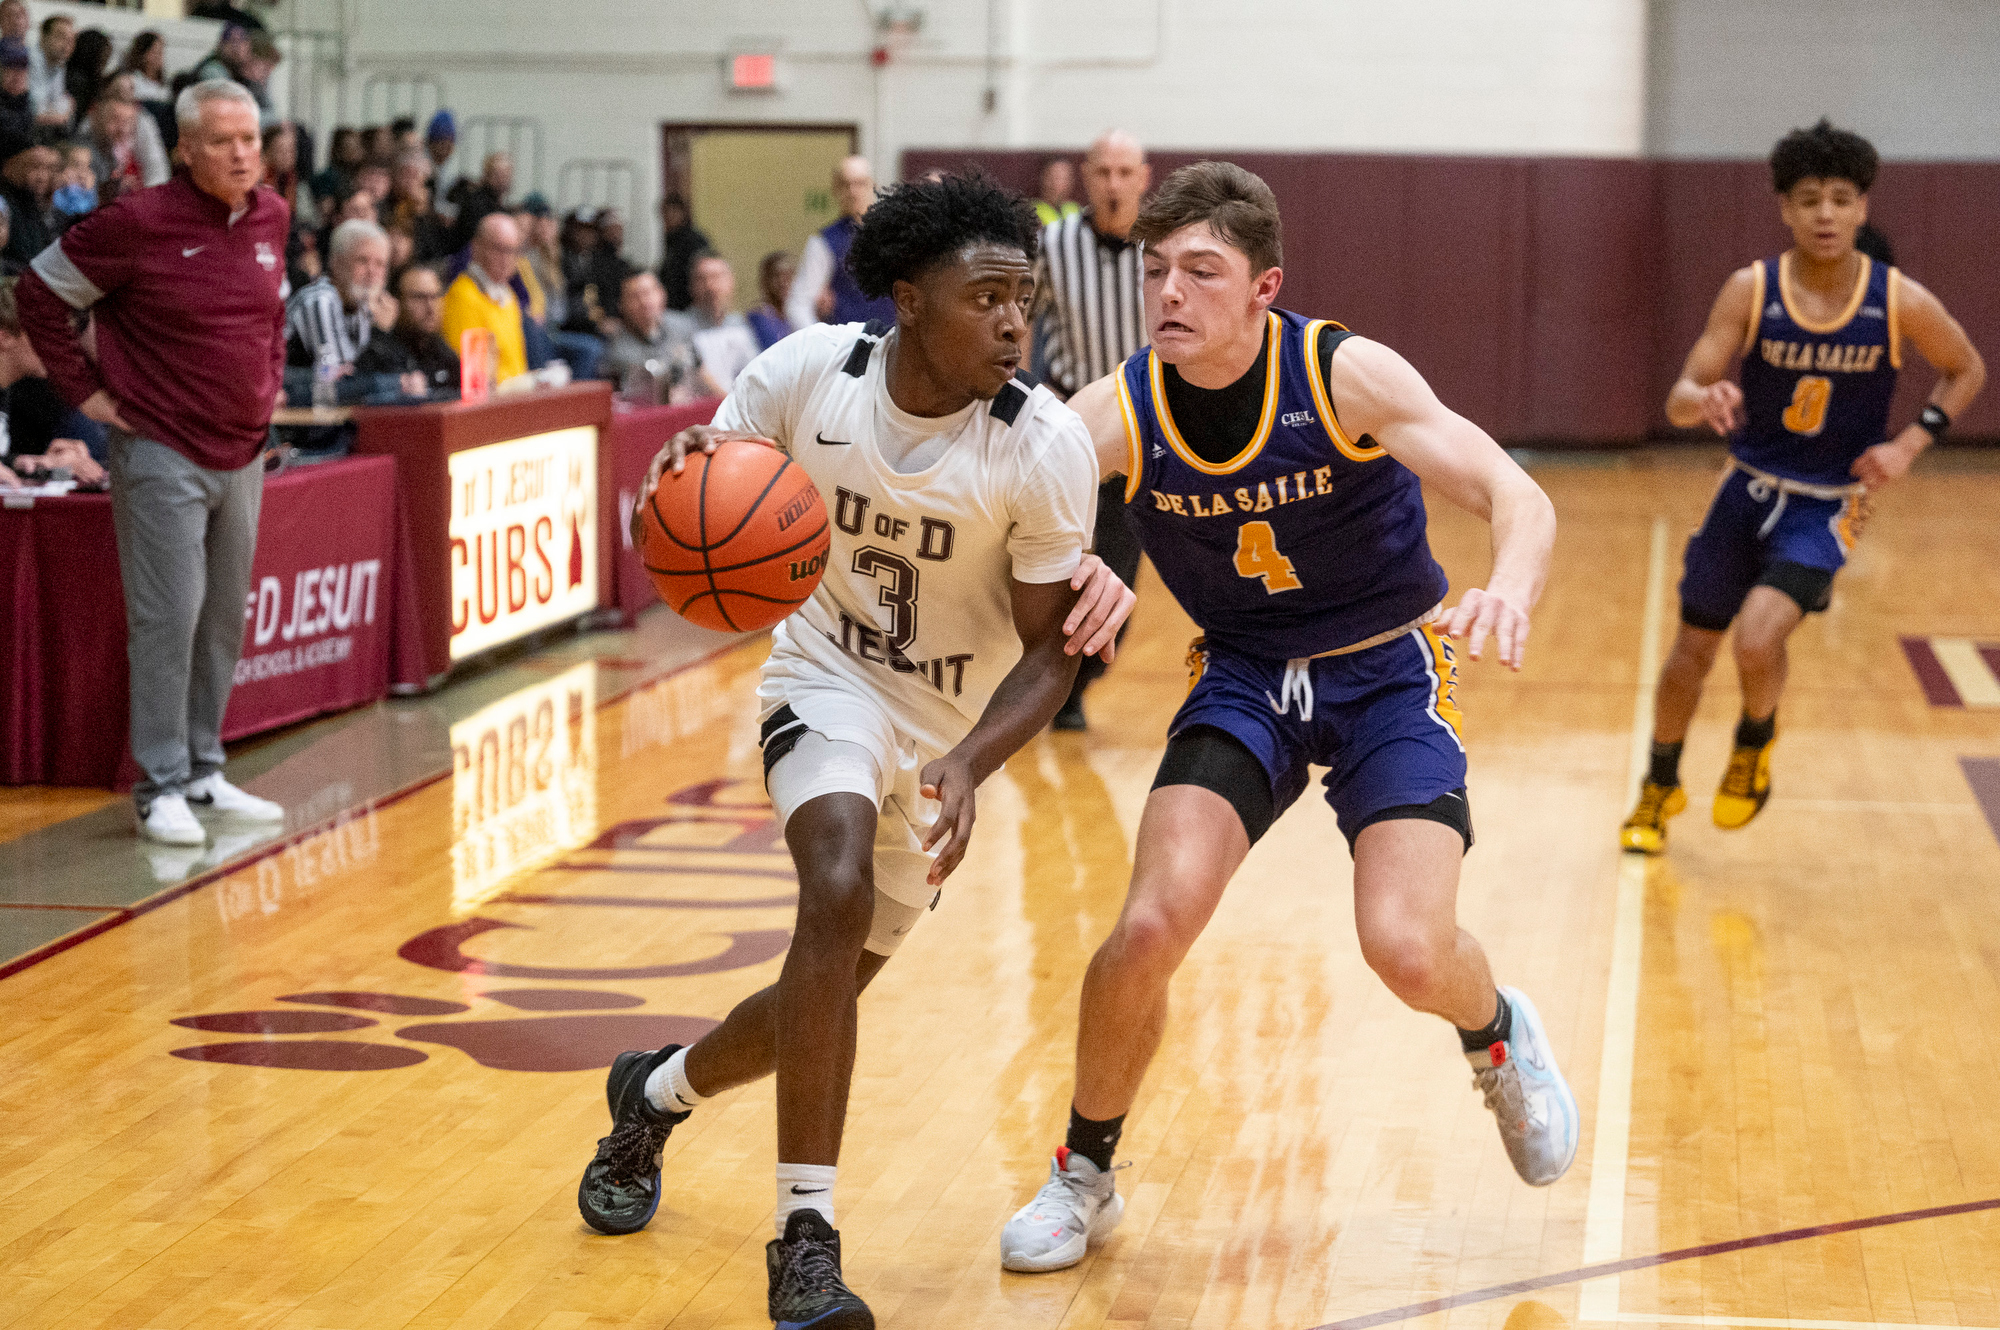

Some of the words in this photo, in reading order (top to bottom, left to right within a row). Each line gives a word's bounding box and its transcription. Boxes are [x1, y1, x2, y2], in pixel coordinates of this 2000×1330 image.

[835, 485, 871, 536] U
[916, 516, 956, 562] D
[1234, 464, 1333, 513] SALLE
[451, 515, 553, 636] CUBS
[1233, 520, 1304, 595] 4
[282, 559, 380, 641] JESUIT
[851, 545, 919, 651] 3
